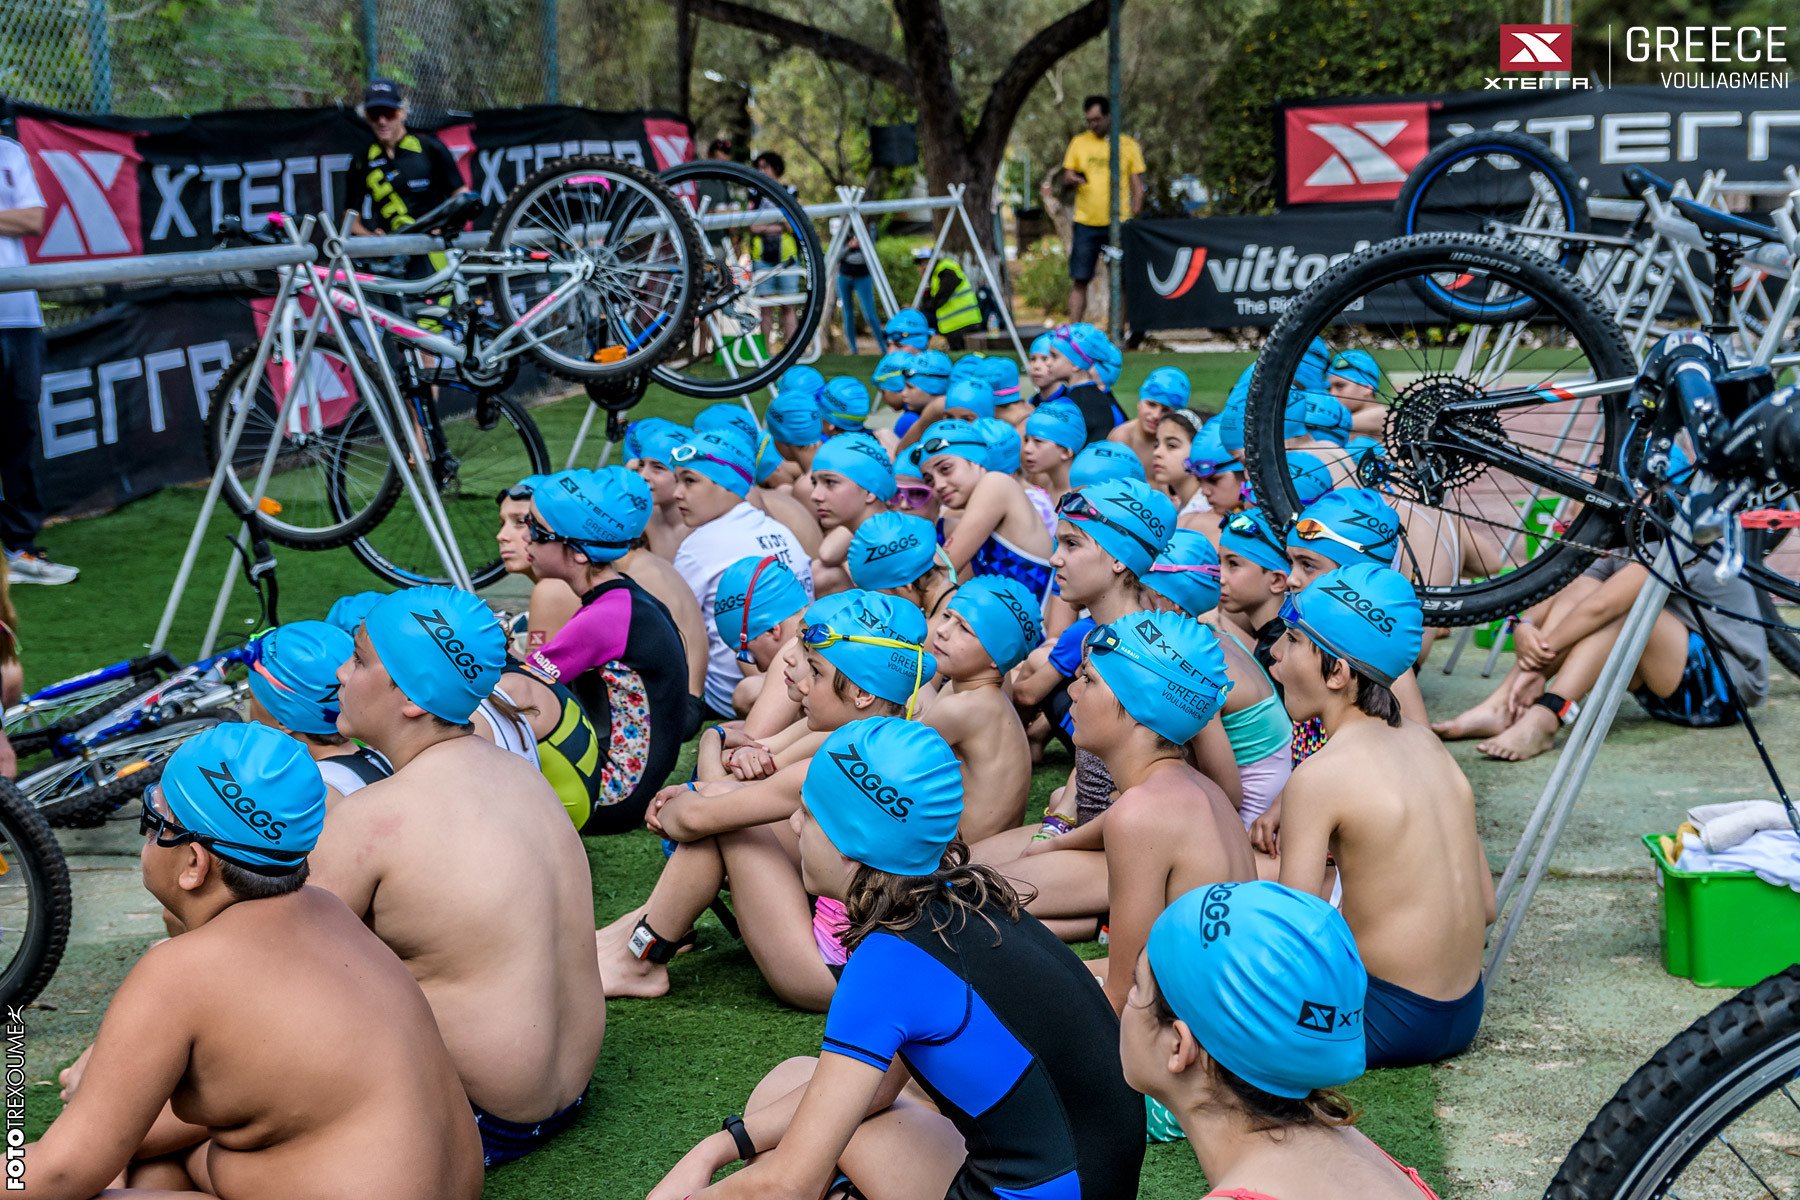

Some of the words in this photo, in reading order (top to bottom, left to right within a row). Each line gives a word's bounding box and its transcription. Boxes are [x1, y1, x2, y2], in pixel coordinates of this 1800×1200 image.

[1446, 110, 1800, 174] XTERR
[150, 152, 353, 241] XTERR
[1206, 240, 1371, 292] vitto
[1234, 297, 1267, 315] The
[39, 339, 233, 460] ERRA
[576, 492, 626, 531] XTERRA
[1103, 492, 1166, 542] ZOGGS
[864, 533, 920, 565] ZOGGS
[714, 593, 747, 616] OGGS
[988, 588, 1037, 643] ZOGGS
[1317, 579, 1398, 638] ZOGGS
[410, 609, 484, 684] ZOGGS
[876, 623, 918, 646] XTE
[887, 661, 918, 679] VOULIAGM
[890, 651, 927, 676] GREEE
[1162, 688, 1204, 721] VOULIAGMEN
[1167, 680, 1212, 714] GREECE
[197, 761, 288, 846] ZOGGS
[827, 743, 914, 824] ZOGGS
[1200, 881, 1241, 950] OGGS
